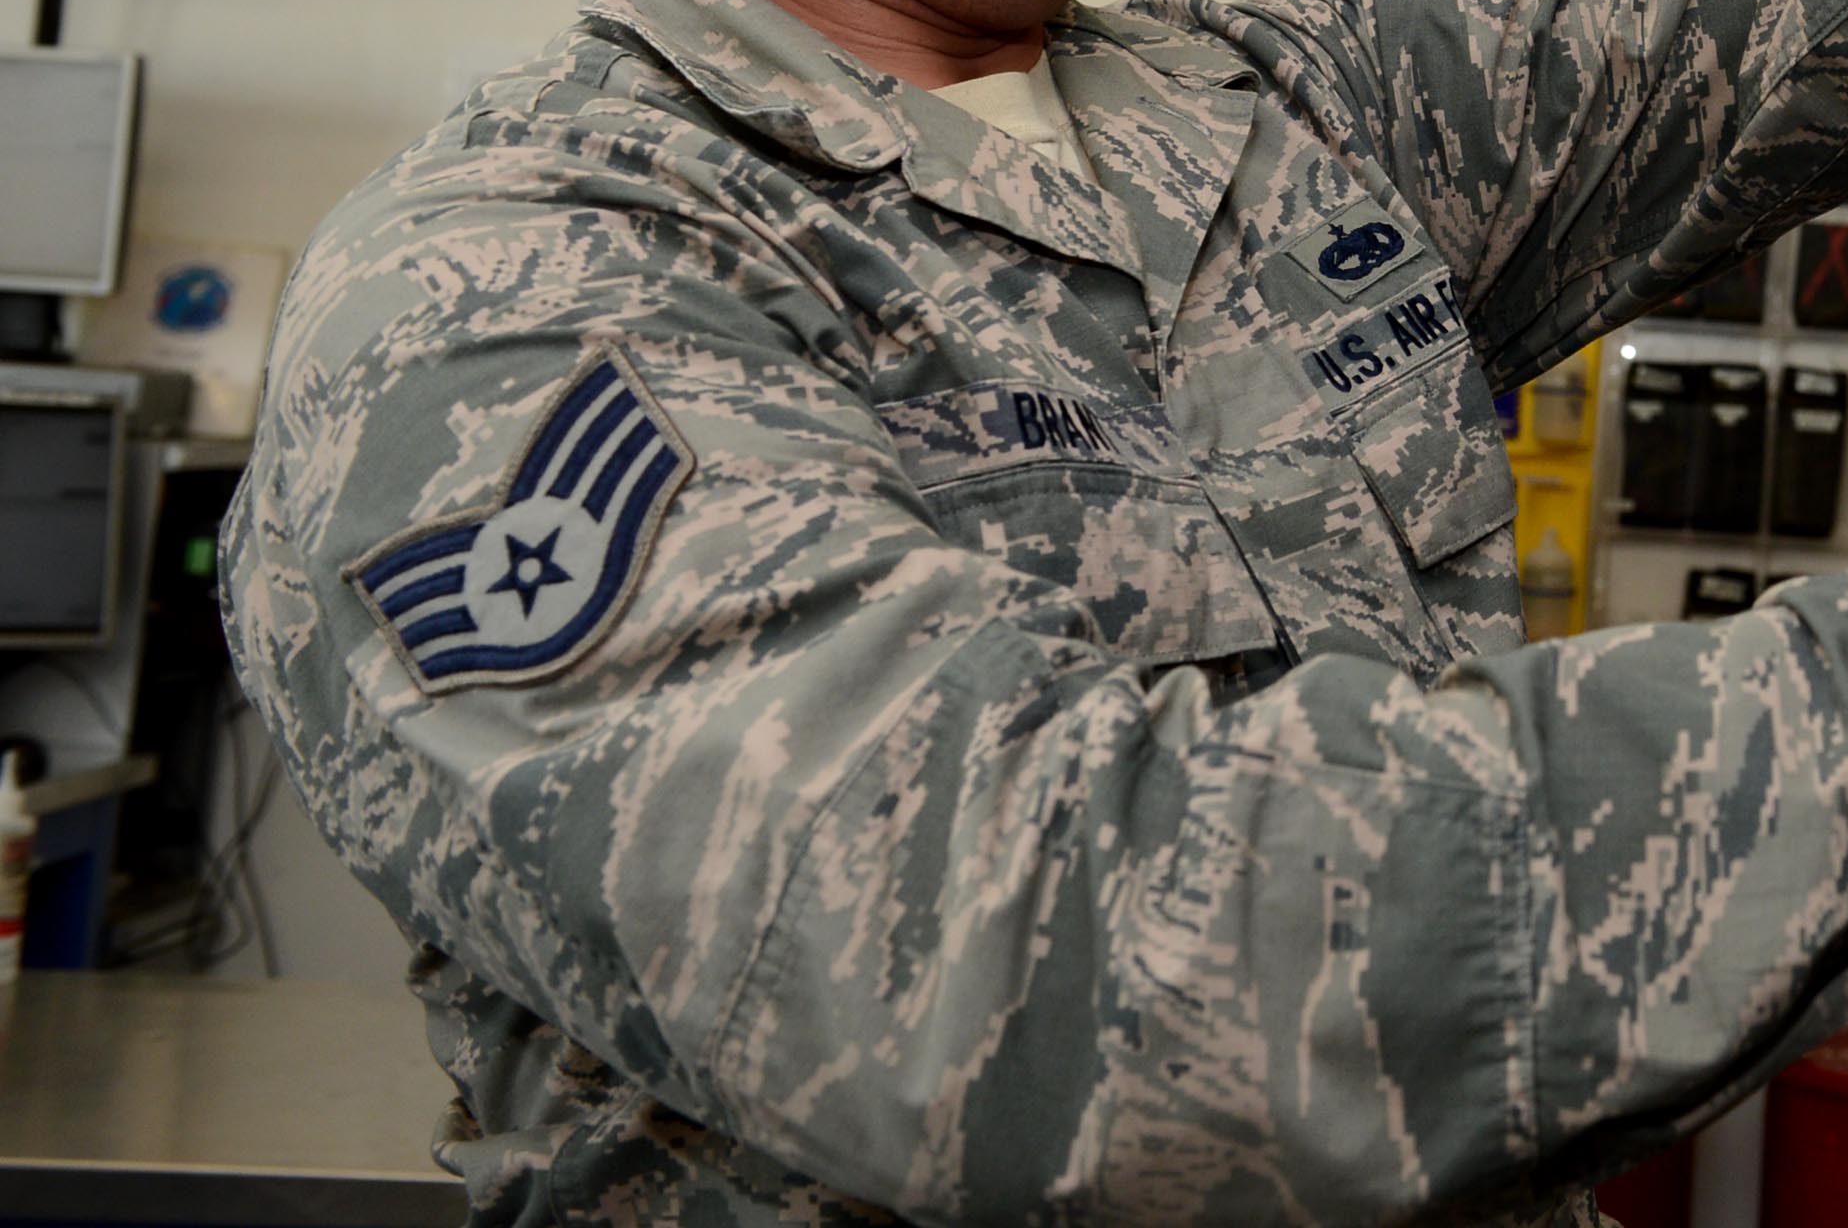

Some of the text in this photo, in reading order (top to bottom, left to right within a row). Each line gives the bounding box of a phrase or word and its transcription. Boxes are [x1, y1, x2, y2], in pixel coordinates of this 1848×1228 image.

[1311, 276, 1464, 393] U.S. AIR F
